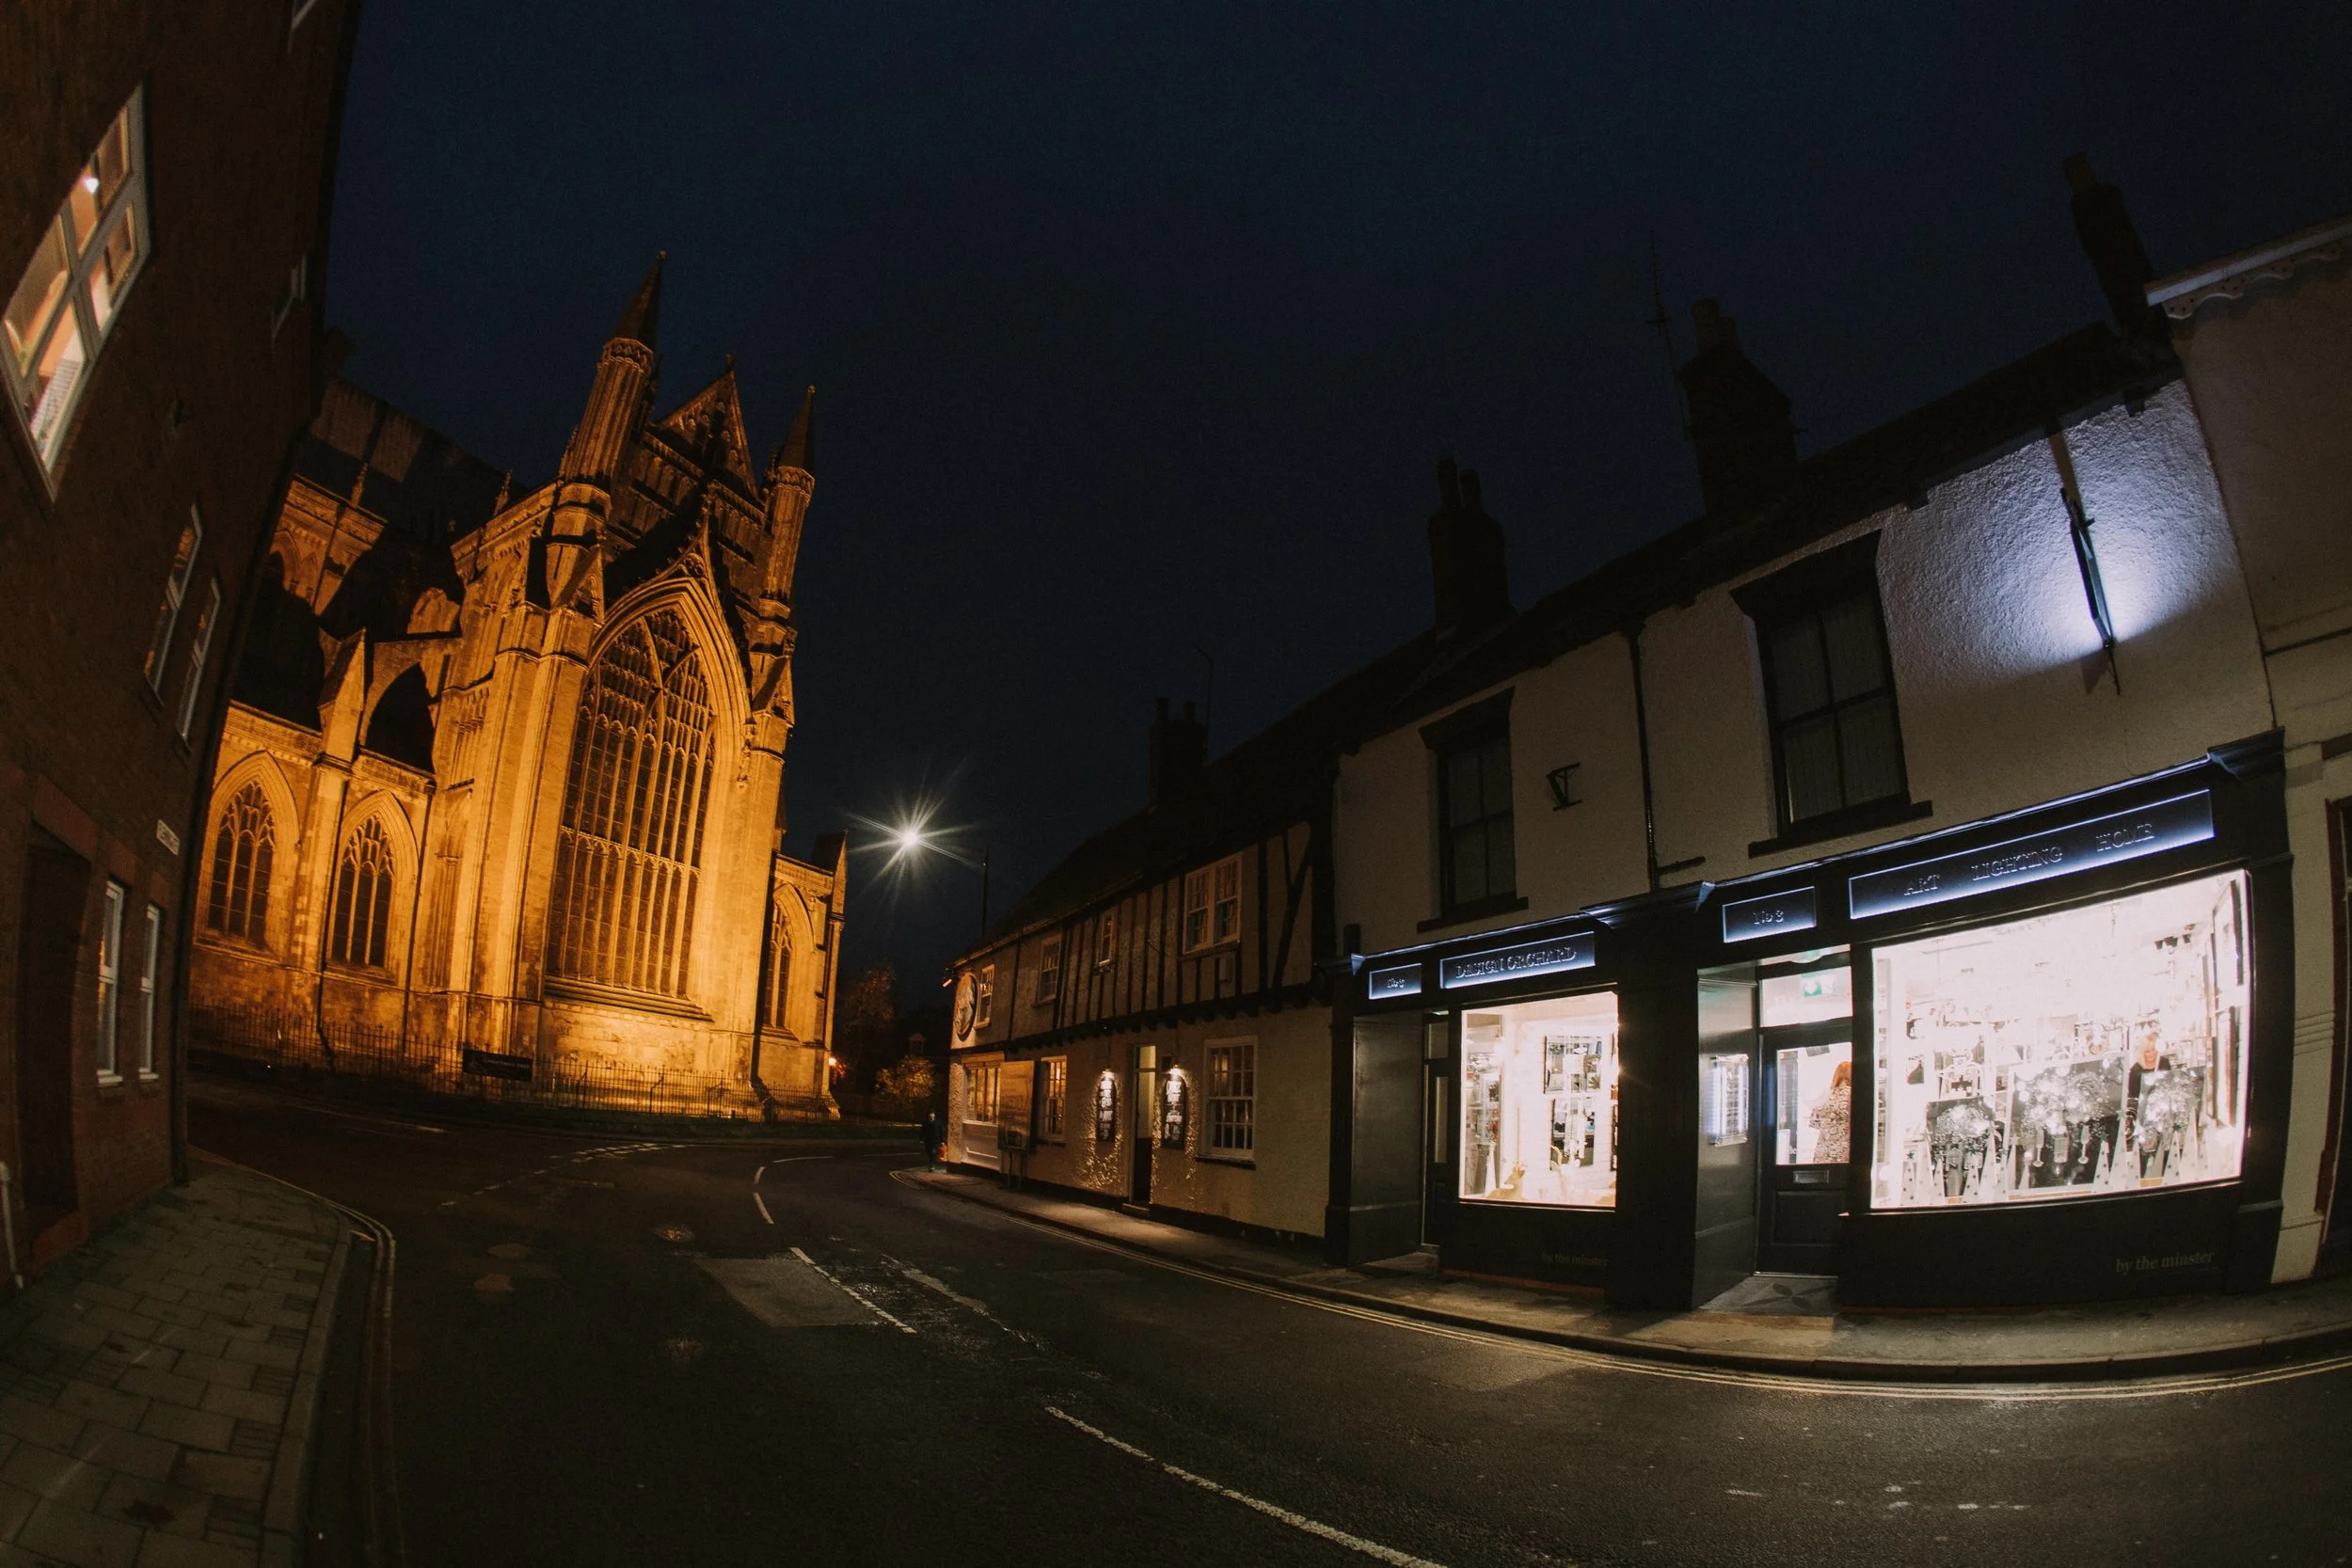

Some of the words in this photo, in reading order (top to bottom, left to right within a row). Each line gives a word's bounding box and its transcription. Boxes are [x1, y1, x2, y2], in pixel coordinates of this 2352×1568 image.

[1903, 874, 1941, 896] ART
[1971, 846, 2064, 881] LIGHTING
[2094, 823, 2155, 852] HOME
[1454, 958, 1503, 979] DESIGN
[1506, 946, 1578, 971] ORCHARD
[2116, 1259, 2133, 1275] by
[2135, 1255, 2159, 1271] the
[2161, 1252, 2217, 1268] minster
